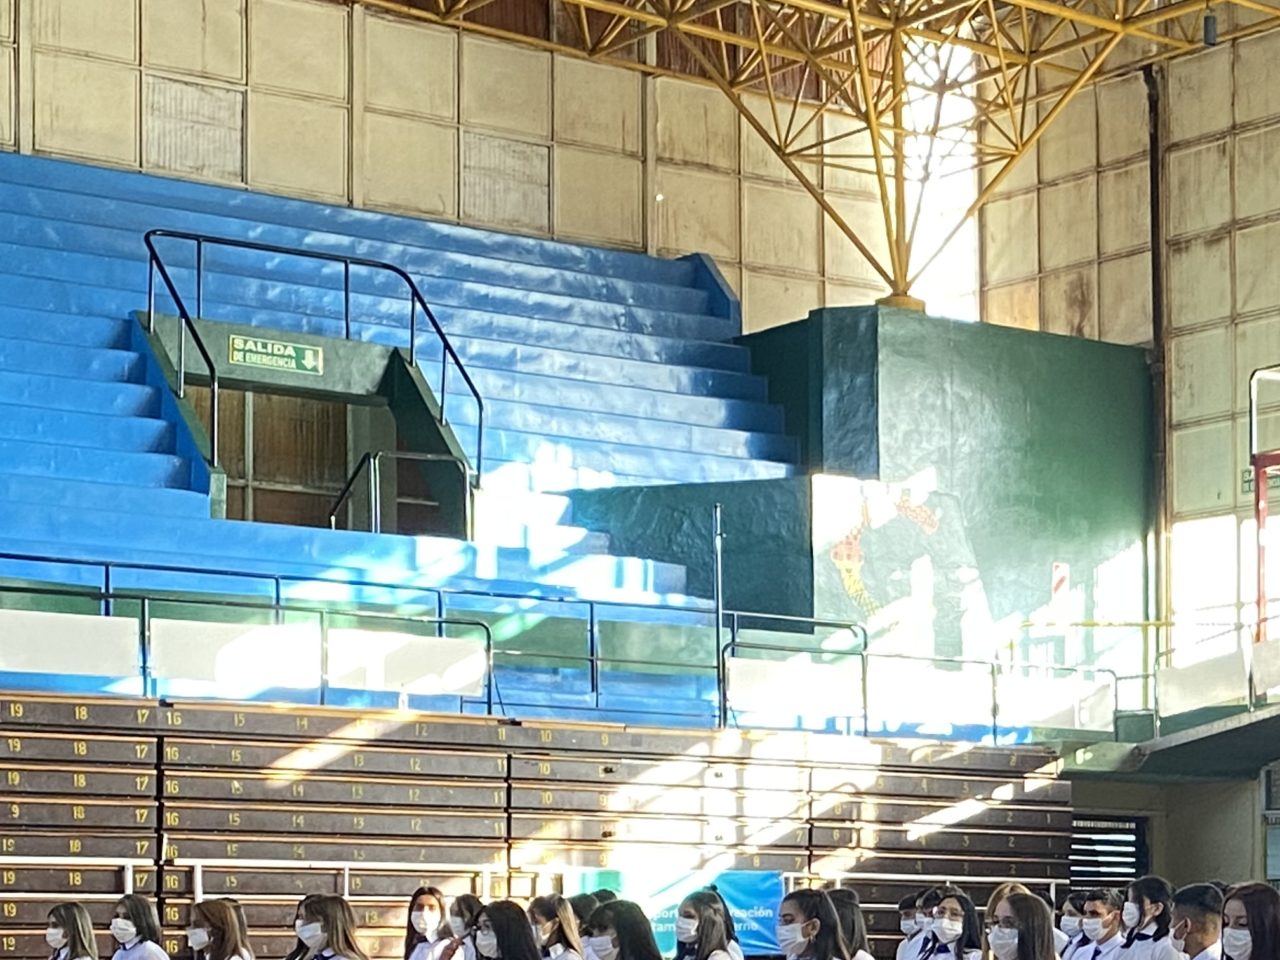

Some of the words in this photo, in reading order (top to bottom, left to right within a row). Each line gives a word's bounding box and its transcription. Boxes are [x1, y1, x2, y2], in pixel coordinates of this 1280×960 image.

[234, 338, 297, 357] SALIDA
[233, 351, 245, 363] DE
[246, 353, 297, 370] EMERGENCIA
[9, 703, 24, 718] 19
[74, 706, 89, 721] 18
[136, 709, 150, 725] 17
[165, 711, 182, 726] 16
[233, 713, 246, 728] 15
[8, 738, 22, 753] 19
[73, 741, 88, 756] 18
[135, 744, 149, 759] 17
[165, 747, 180, 761] 16
[231, 749, 242, 762] 15
[7, 771, 20, 786] 19
[73, 774, 87, 788] 18
[135, 776, 149, 792] 17
[165, 780, 180, 794] 16
[72, 805, 86, 820] 18
[135, 808, 149, 823] 17
[165, 812, 180, 826] 16
[135, 841, 150, 856] 17
[165, 844, 179, 859] 16
[2, 871, 16, 885] 19
[68, 872, 82, 886] 18
[135, 873, 149, 888] 17
[164, 875, 180, 889] 16
[3, 902, 17, 917] 19
[165, 907, 180, 921] 16
[164, 939, 179, 954] 16
